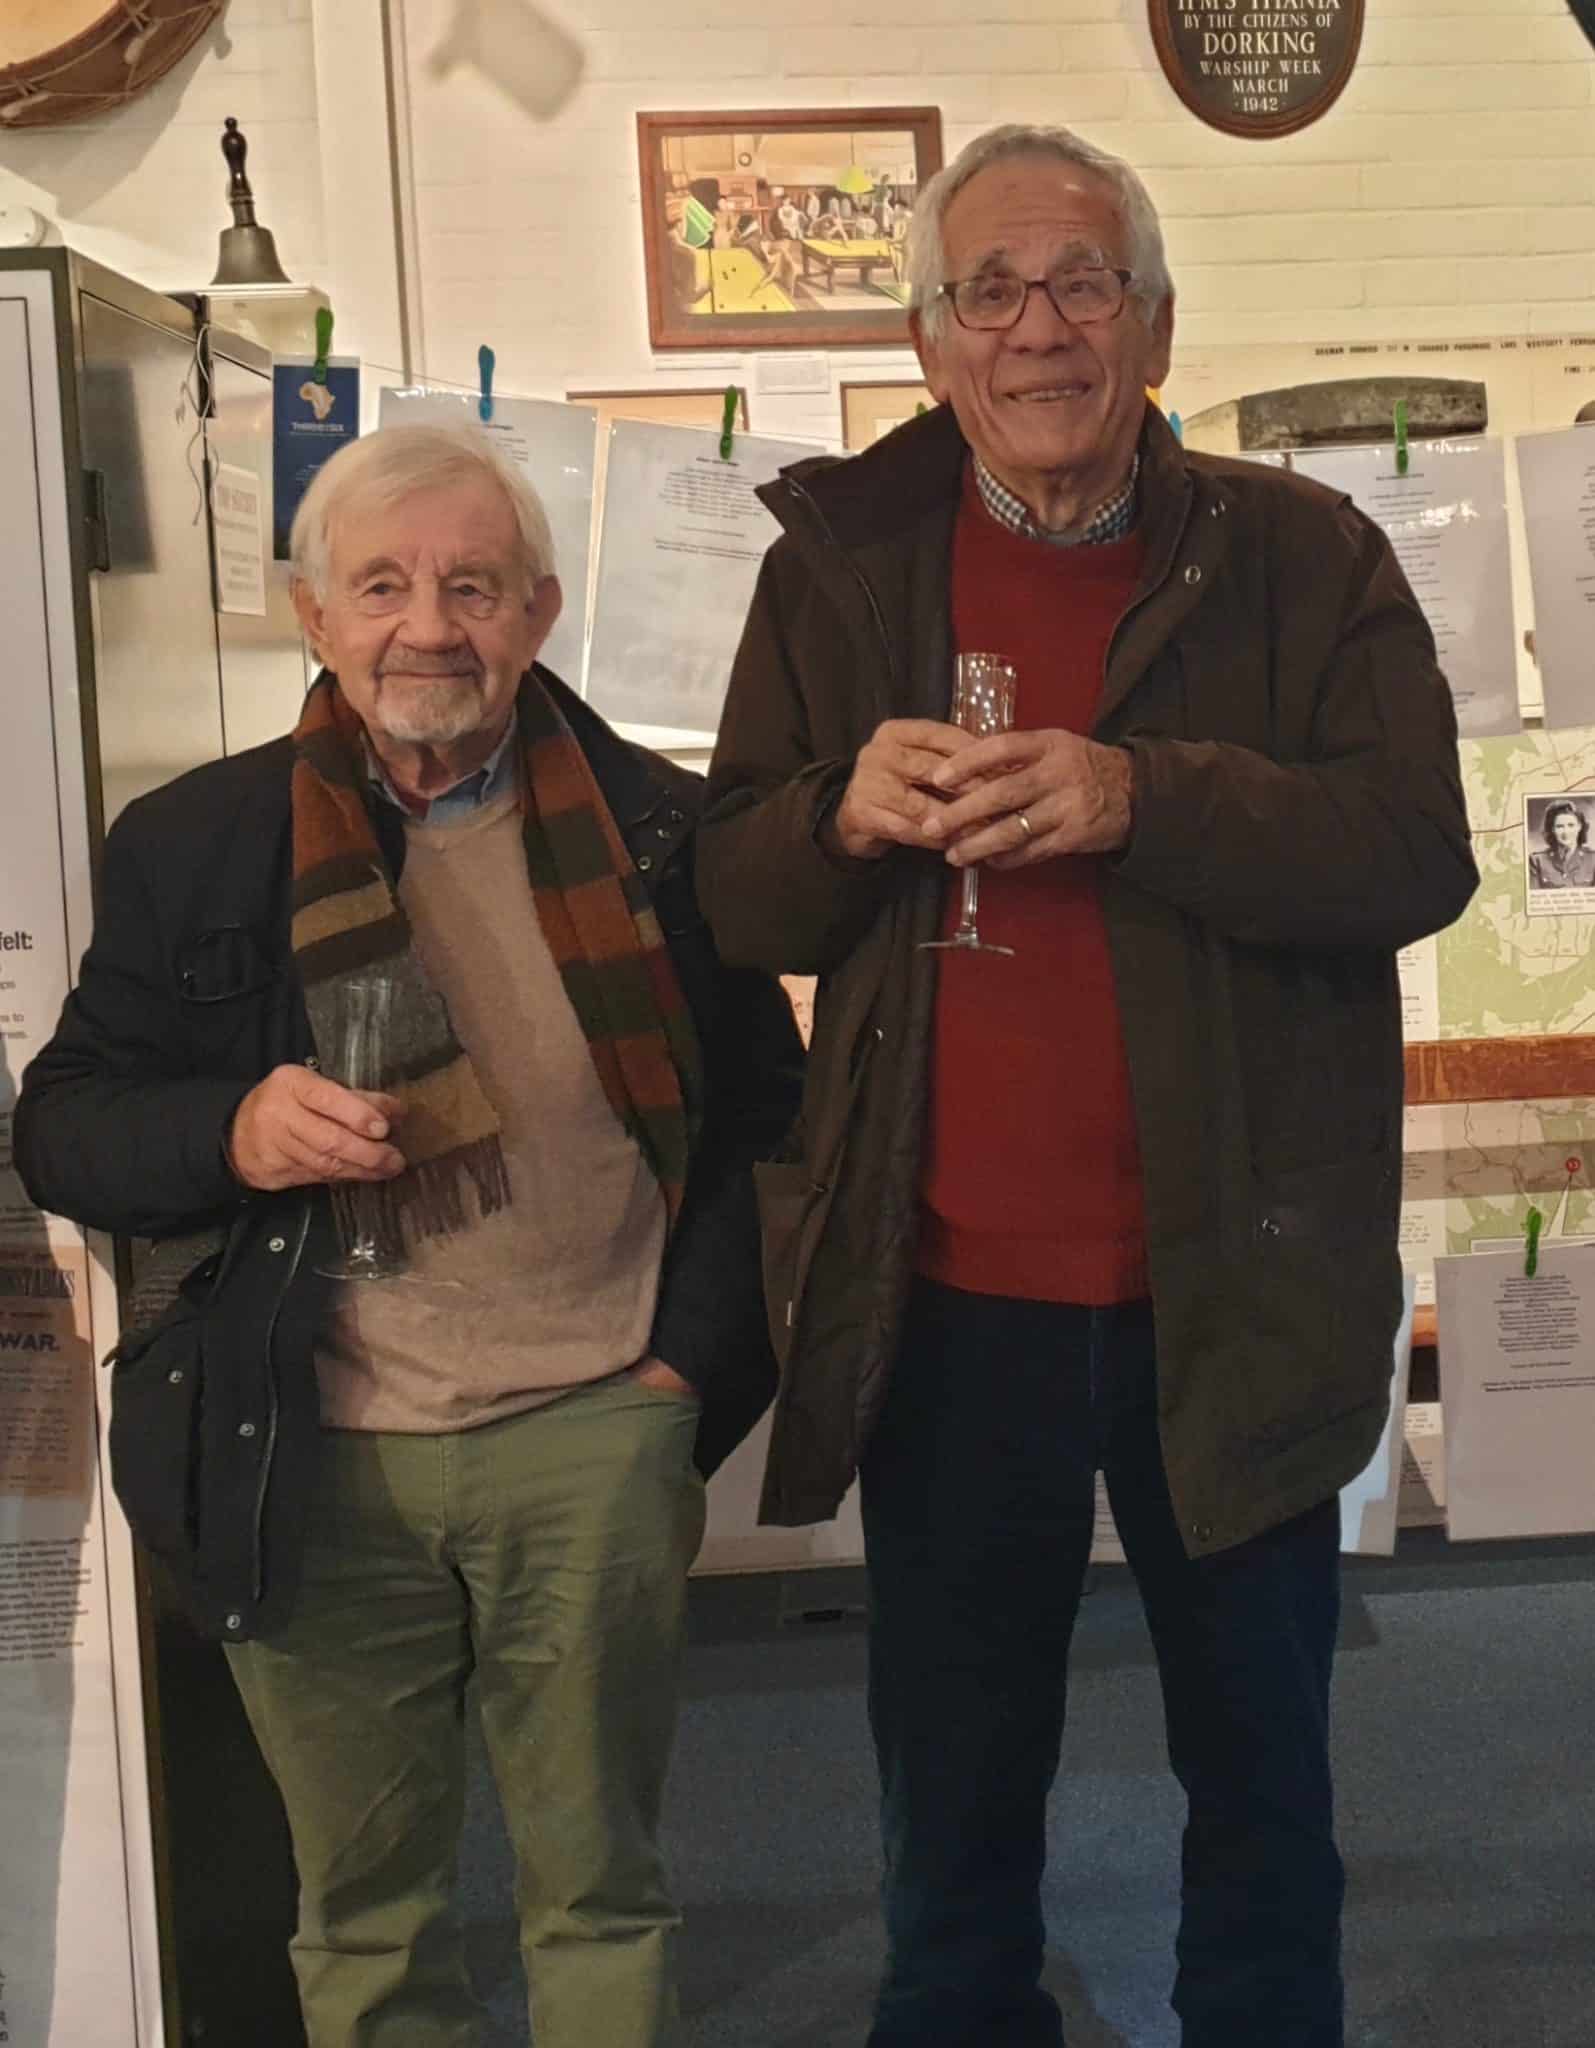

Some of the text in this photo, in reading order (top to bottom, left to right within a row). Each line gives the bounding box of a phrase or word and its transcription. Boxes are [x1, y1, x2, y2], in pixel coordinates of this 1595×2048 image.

[1184, 14, 1334, 29] BY THE CITIZENS OF
[1203, 31, 1316, 55] DORKING
[1200, 60, 1321, 75] WARSHIP WEEK
[1232, 78, 1289, 93] MARCH
